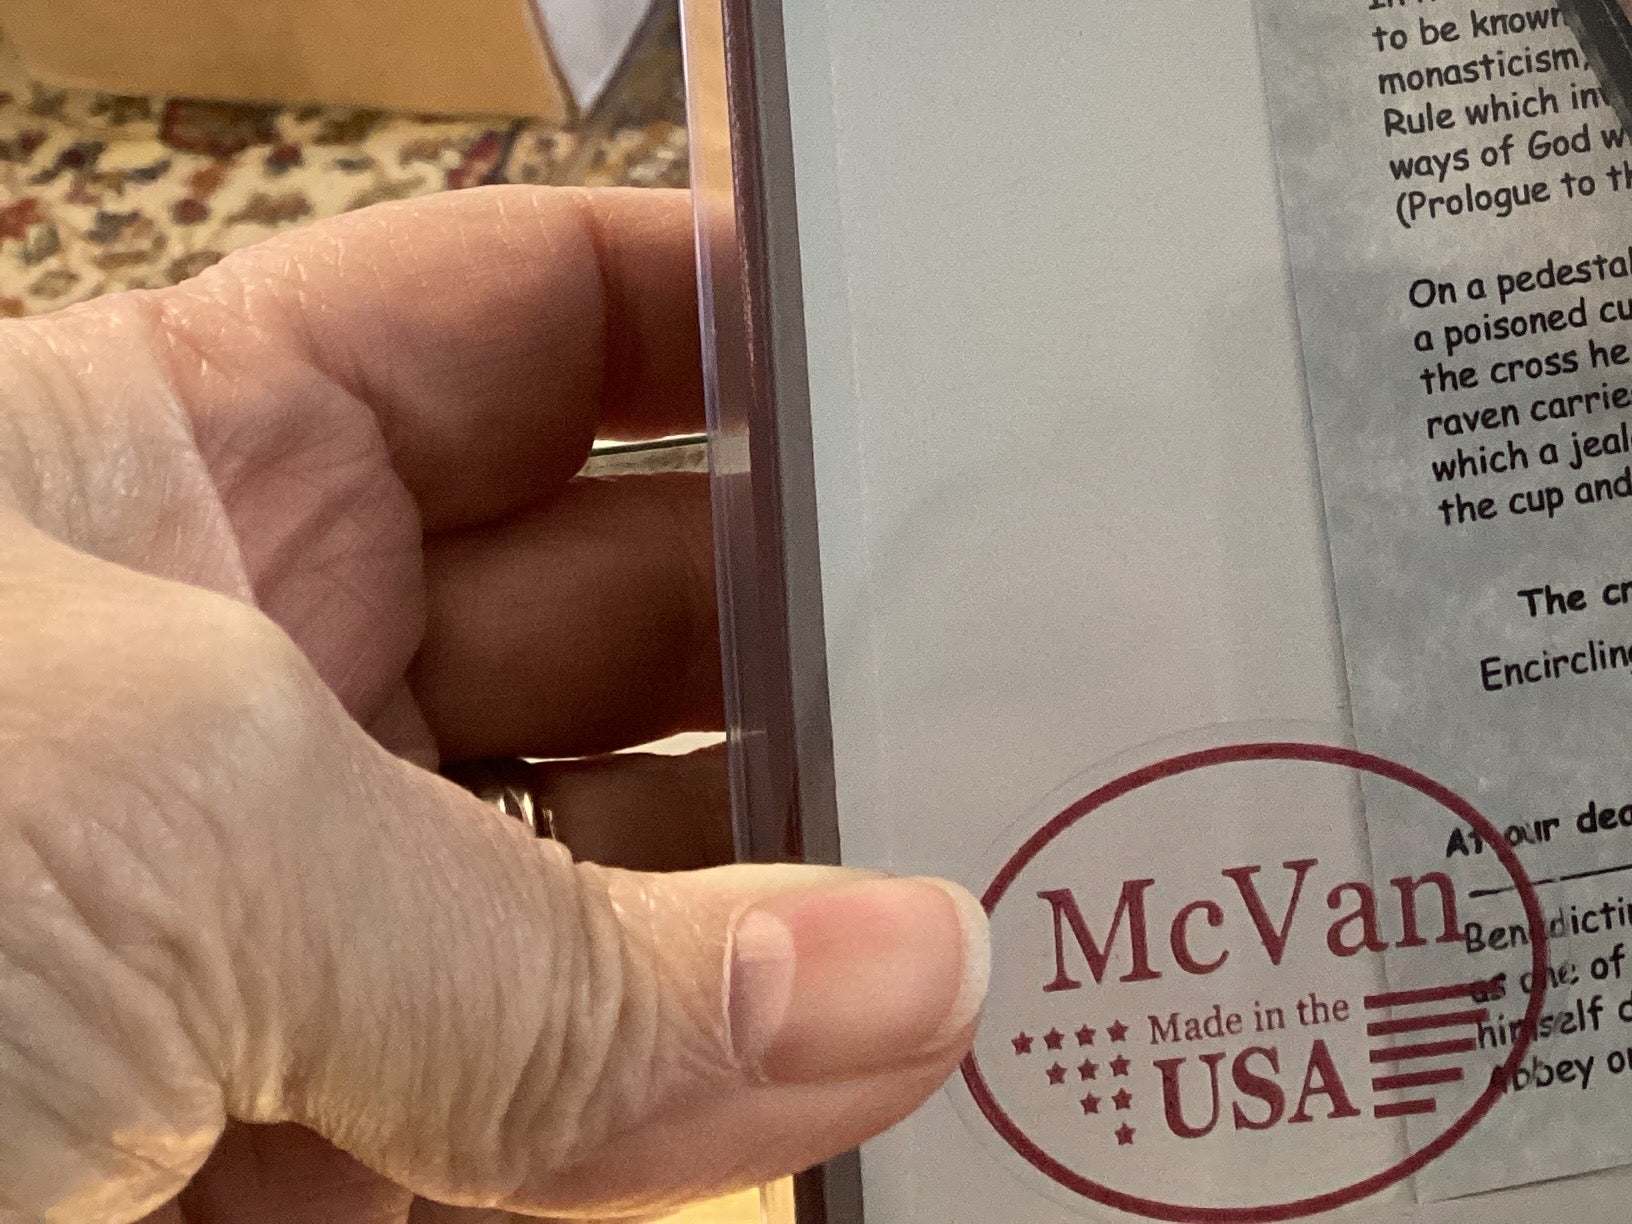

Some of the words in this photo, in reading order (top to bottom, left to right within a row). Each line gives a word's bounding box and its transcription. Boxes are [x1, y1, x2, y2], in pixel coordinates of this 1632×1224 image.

[1372, 26, 1408, 52] to
[1419, 17, 1460, 45] be
[1470, 7, 1563, 39] known
[1378, 47, 1590, 96] monasticism,
[1384, 102, 1456, 138] Rule
[1465, 86, 1560, 127] which
[1389, 147, 1471, 184] ways
[1480, 133, 1515, 167] of
[1528, 123, 1592, 161] God
[1396, 182, 1551, 229] (Prologue
[1560, 172, 1595, 199] to
[1409, 278, 1457, 310] On
[1467, 277, 1488, 301] a
[1414, 330, 1434, 352] a
[1444, 296, 1588, 357] poisoned
[1419, 366, 1480, 396] the
[1490, 350, 1579, 384] cross
[1588, 339, 1630, 368] he
[1427, 401, 1520, 440] raven
[1432, 440, 1529, 483] which
[1539, 441, 1560, 466] a
[1438, 493, 1498, 526] the
[1509, 487, 1564, 518] cup
[1517, 584, 1587, 618] The
[1504, 817, 1561, 847] our
[1036, 858, 1466, 993] McVan
[1590, 943, 1625, 980] of
[1147, 1003, 1243, 1047] Made
[1253, 998, 1286, 1032] in
[1297, 992, 1352, 1027] the
[1153, 1038, 1361, 1140] USA
